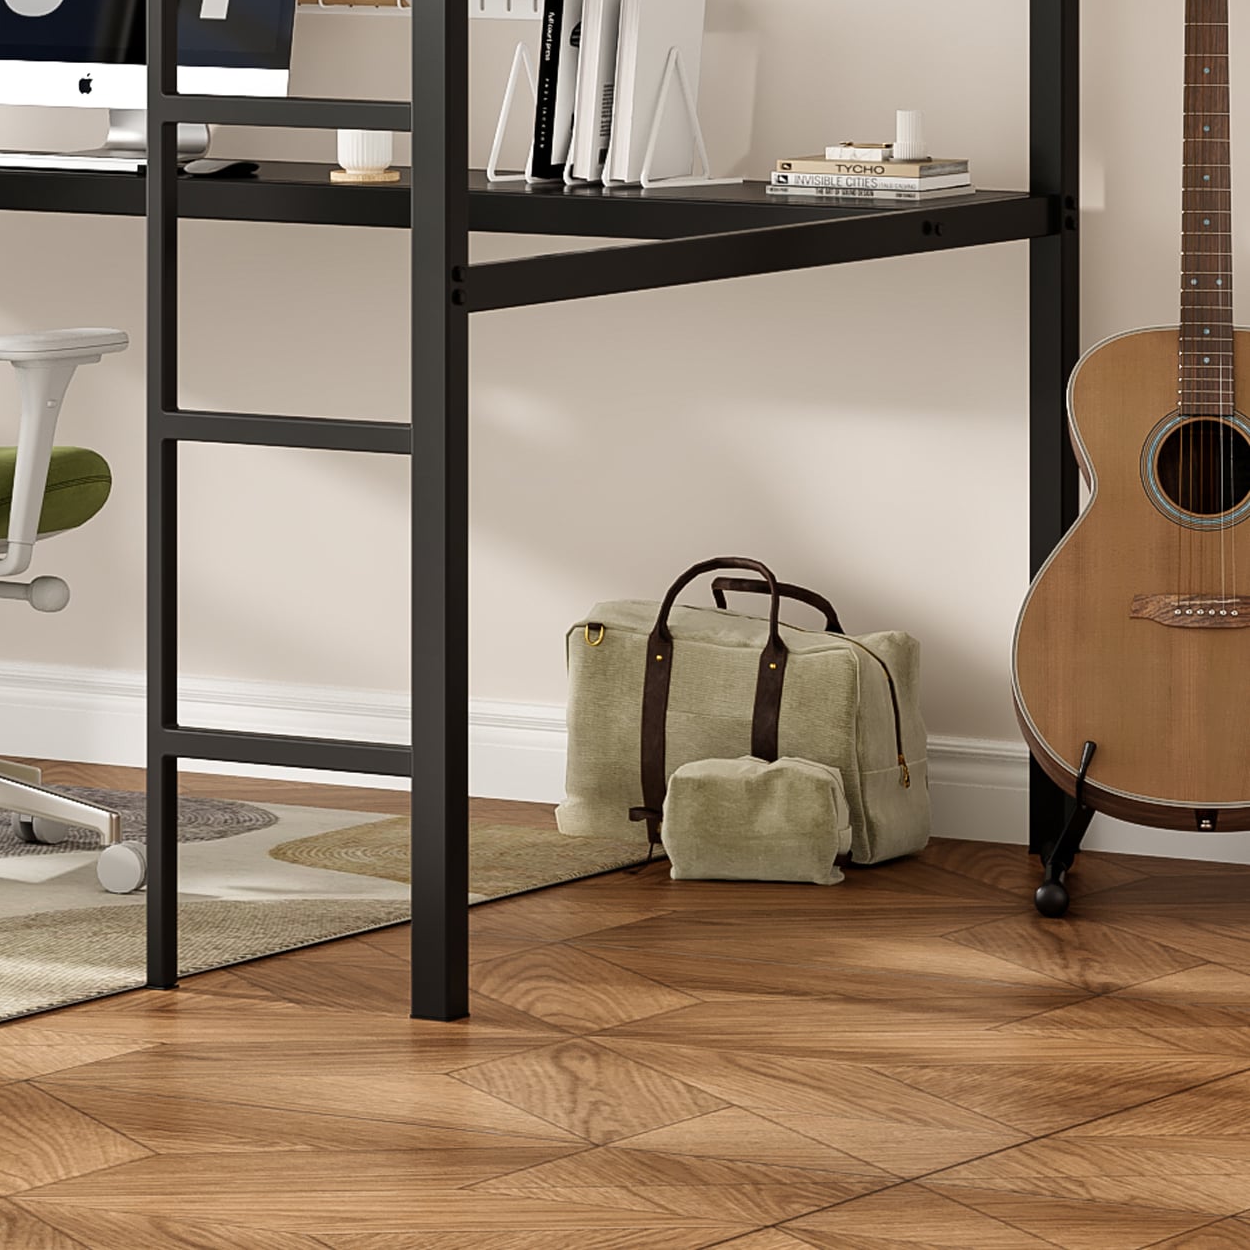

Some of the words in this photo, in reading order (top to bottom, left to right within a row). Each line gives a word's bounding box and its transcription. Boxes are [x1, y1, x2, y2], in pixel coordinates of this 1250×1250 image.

[835, 164, 885, 174] TYCHO
[794, 174, 842, 186] INVISIBLE
[846, 176, 878, 188] CITIES
